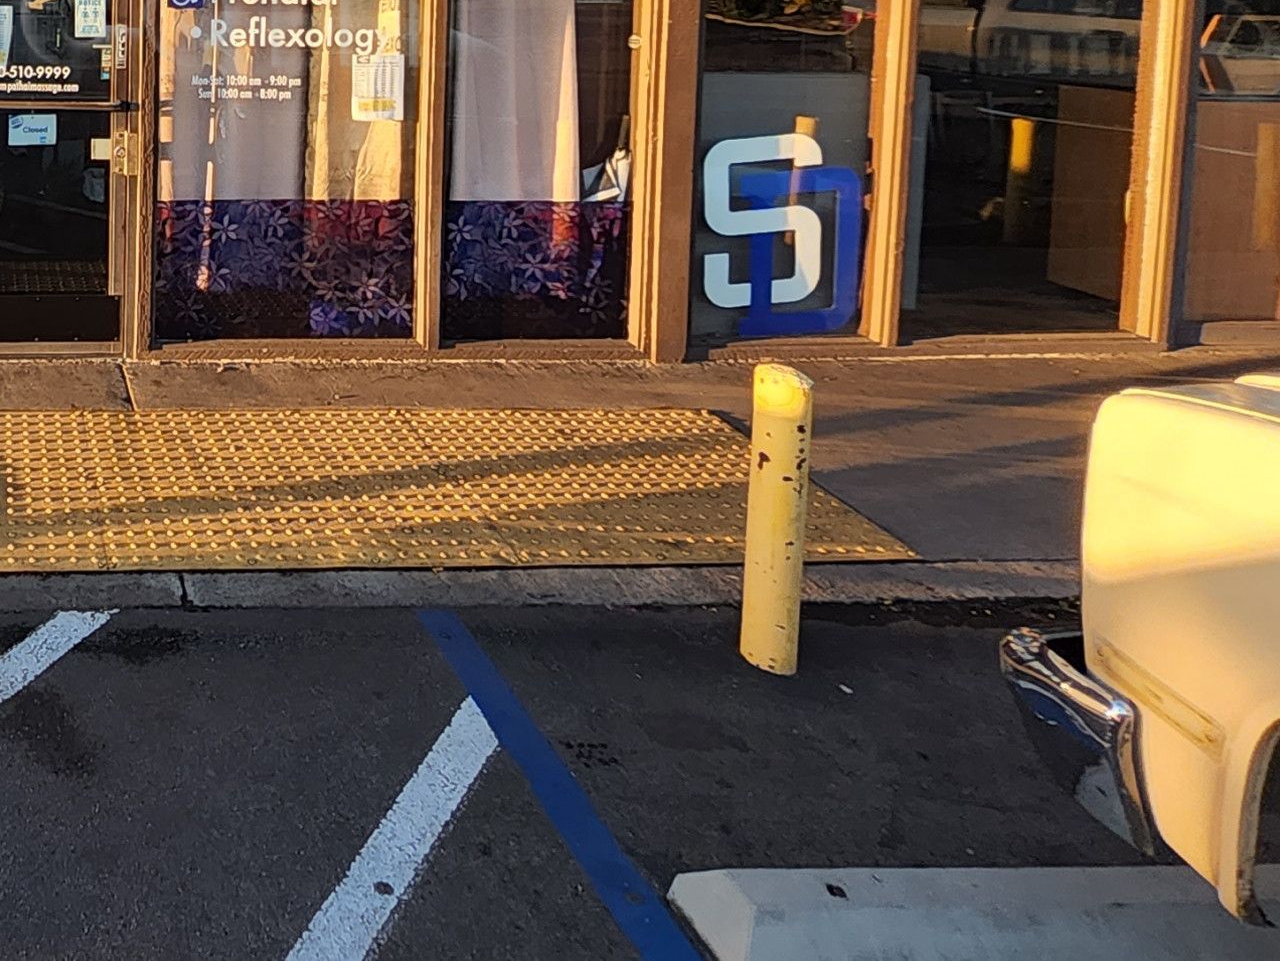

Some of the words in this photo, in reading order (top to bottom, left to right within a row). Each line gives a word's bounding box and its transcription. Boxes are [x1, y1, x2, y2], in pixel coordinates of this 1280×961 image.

[210, 16, 389, 56] Reflexology
[226, 74, 248, 86] 10:00
[249, 77, 262, 86] am
[270, 74, 288, 86] 9:00
[288, 77, 302, 89] pm
[198, 88, 215, 99] Sun
[278, 90, 292, 102] pm
